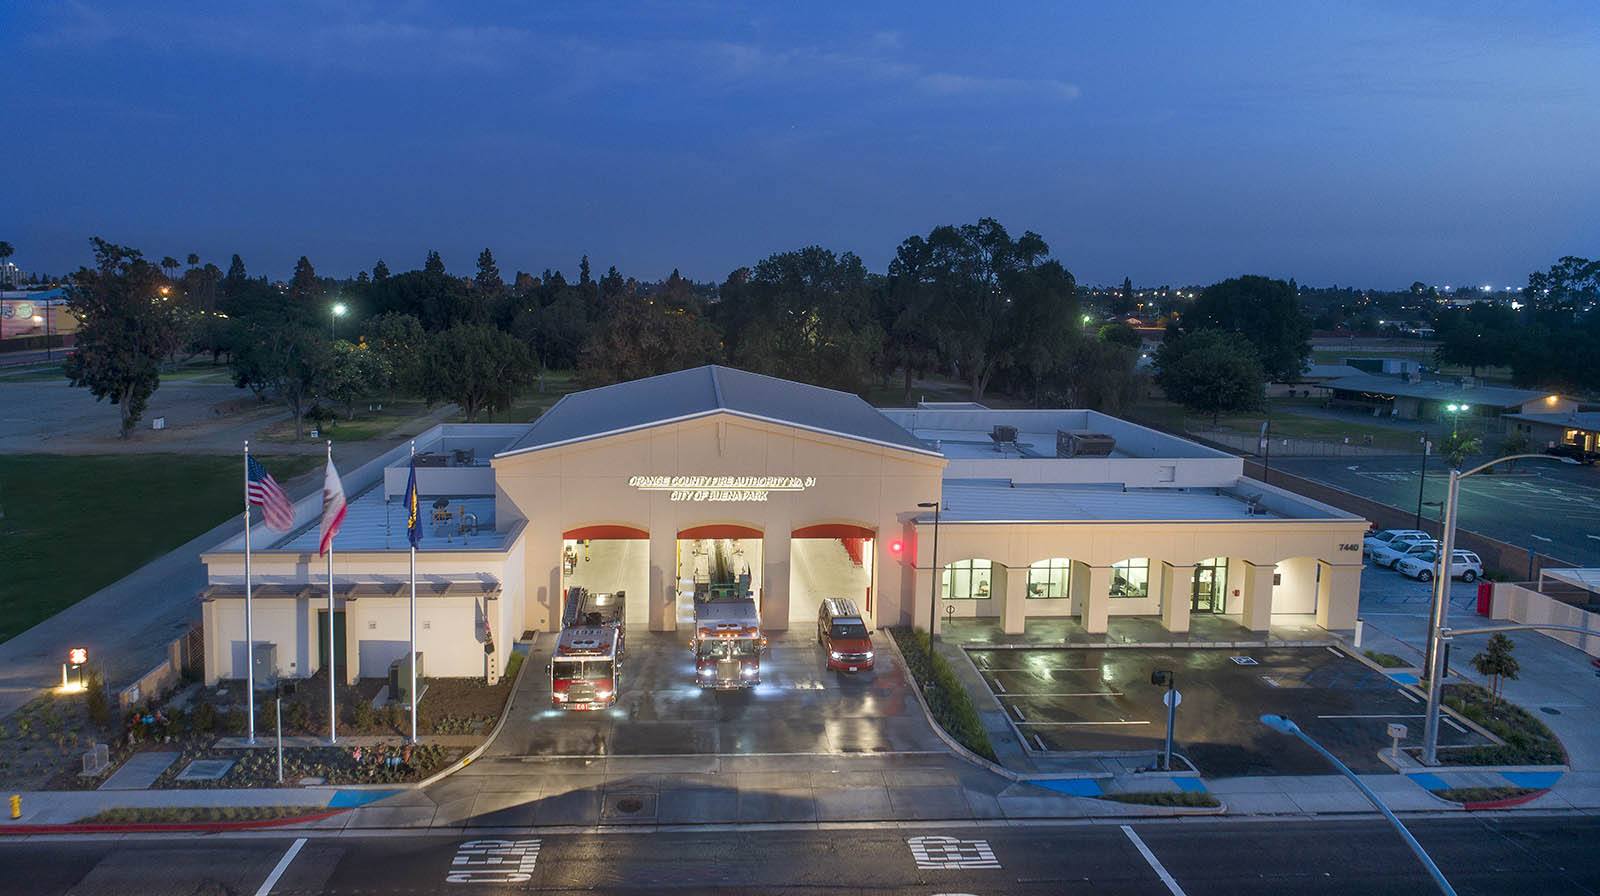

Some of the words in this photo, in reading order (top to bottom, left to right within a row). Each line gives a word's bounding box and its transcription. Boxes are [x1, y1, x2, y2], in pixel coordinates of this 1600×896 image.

[628, 476, 671, 487] ORANGE
[671, 476, 712, 487] COUNTY
[711, 476, 735, 487] FIRE
[734, 476, 790, 487] AUTHORITY
[670, 490, 693, 501] CITY
[693, 490, 710, 501] OF
[708, 490, 743, 502] BUENA
[741, 490, 769, 502] PARK
[1339, 543, 1359, 551] 7440
[907, 835, 1002, 870] KEEP
[446, 839, 542, 883] CLEAR
